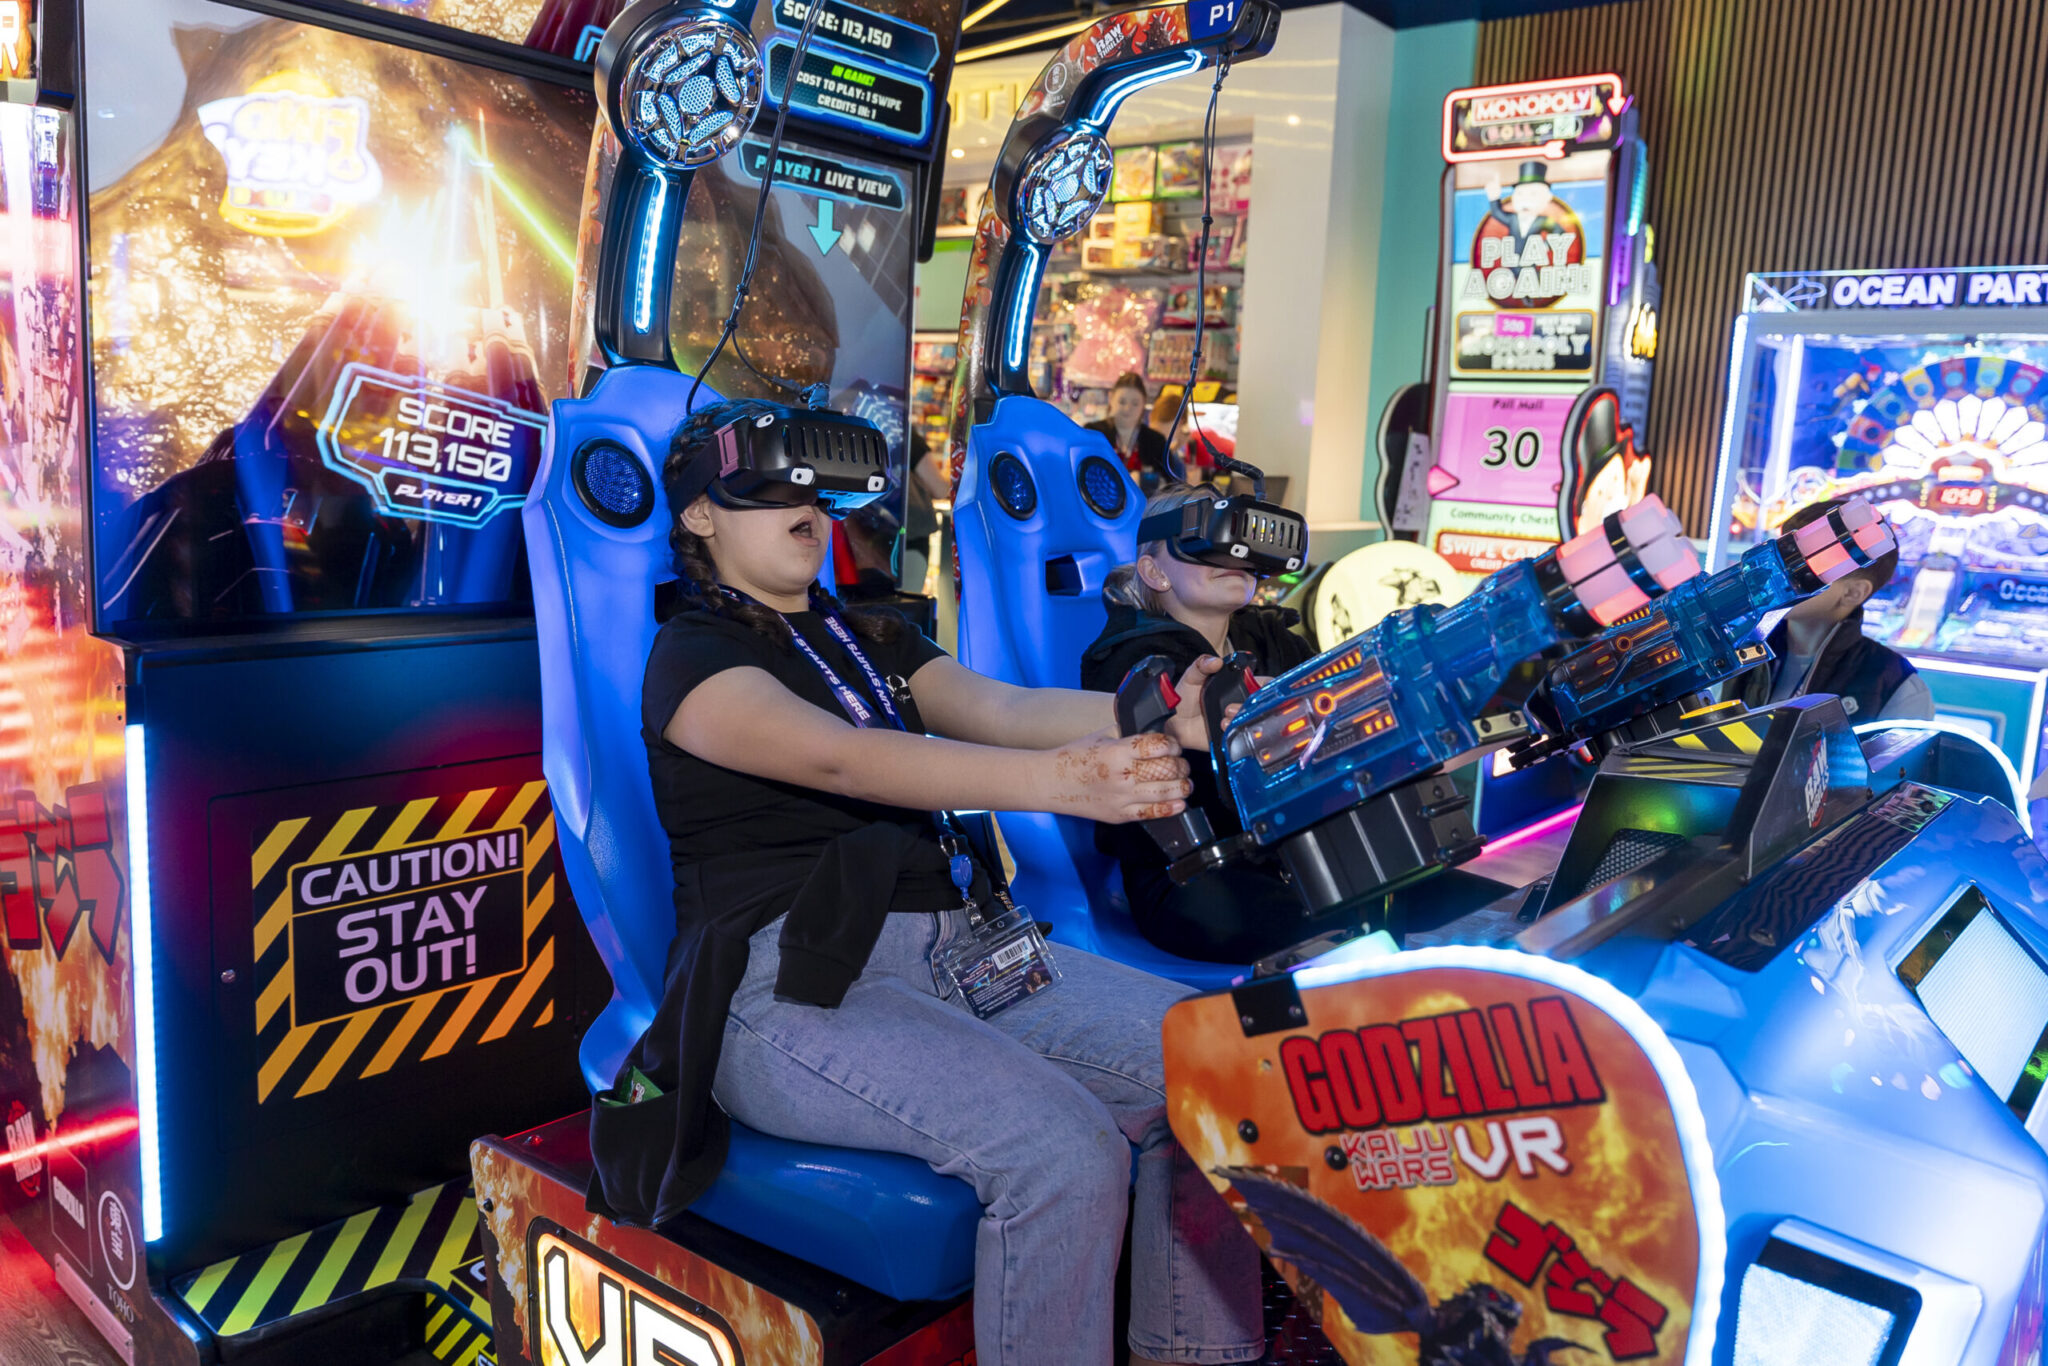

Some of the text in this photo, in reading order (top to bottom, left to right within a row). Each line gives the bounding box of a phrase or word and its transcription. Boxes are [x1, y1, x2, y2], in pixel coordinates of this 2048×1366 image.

[783, 0, 893, 49] SCRE: 113,150
[1208, 1, 1234, 26] P1
[1095, 23, 1122, 53] RAW
[1099, 34, 1125, 59] THRILLS
[831, 64, 842, 77] IN
[796, 71, 821, 88] COST
[823, 79, 835, 92] TO
[836, 83, 865, 101] PLAY:
[872, 93, 902, 111] SWIPE
[817, 94, 877, 119] CREDITS IN: 1
[1477, 87, 1591, 121] MONOPOLY
[755, 155, 892, 198] PAYER 1 LIVE VIEW
[1481, 233, 1576, 268] PLAY
[1832, 274, 1957, 306] OCEAN
[397, 397, 515, 448] SCORE
[1518, 399, 1543, 410] Mall
[379, 427, 512, 482] 113,150
[1480, 426, 1543, 471] 30
[394, 484, 483, 509] PLAYER 1
[1450, 508, 1556, 525] Community Chest
[1441, 537, 1498, 559] SWIPE
[796, 638, 871, 720] STARTS HERE
[825, 616, 896, 716] FUN STARTS HERE
[300, 833, 518, 906] CAUTION!
[336, 885, 488, 959] STAY
[344, 934, 476, 1003] OUT!
[1280, 996, 1607, 1133] GODZILLA
[1340, 1123, 1453, 1161] KAIJU
[1453, 1115, 1572, 1180] VR
[1353, 1153, 1458, 1191] WARS
[107, 1281, 135, 1324] TOHO
